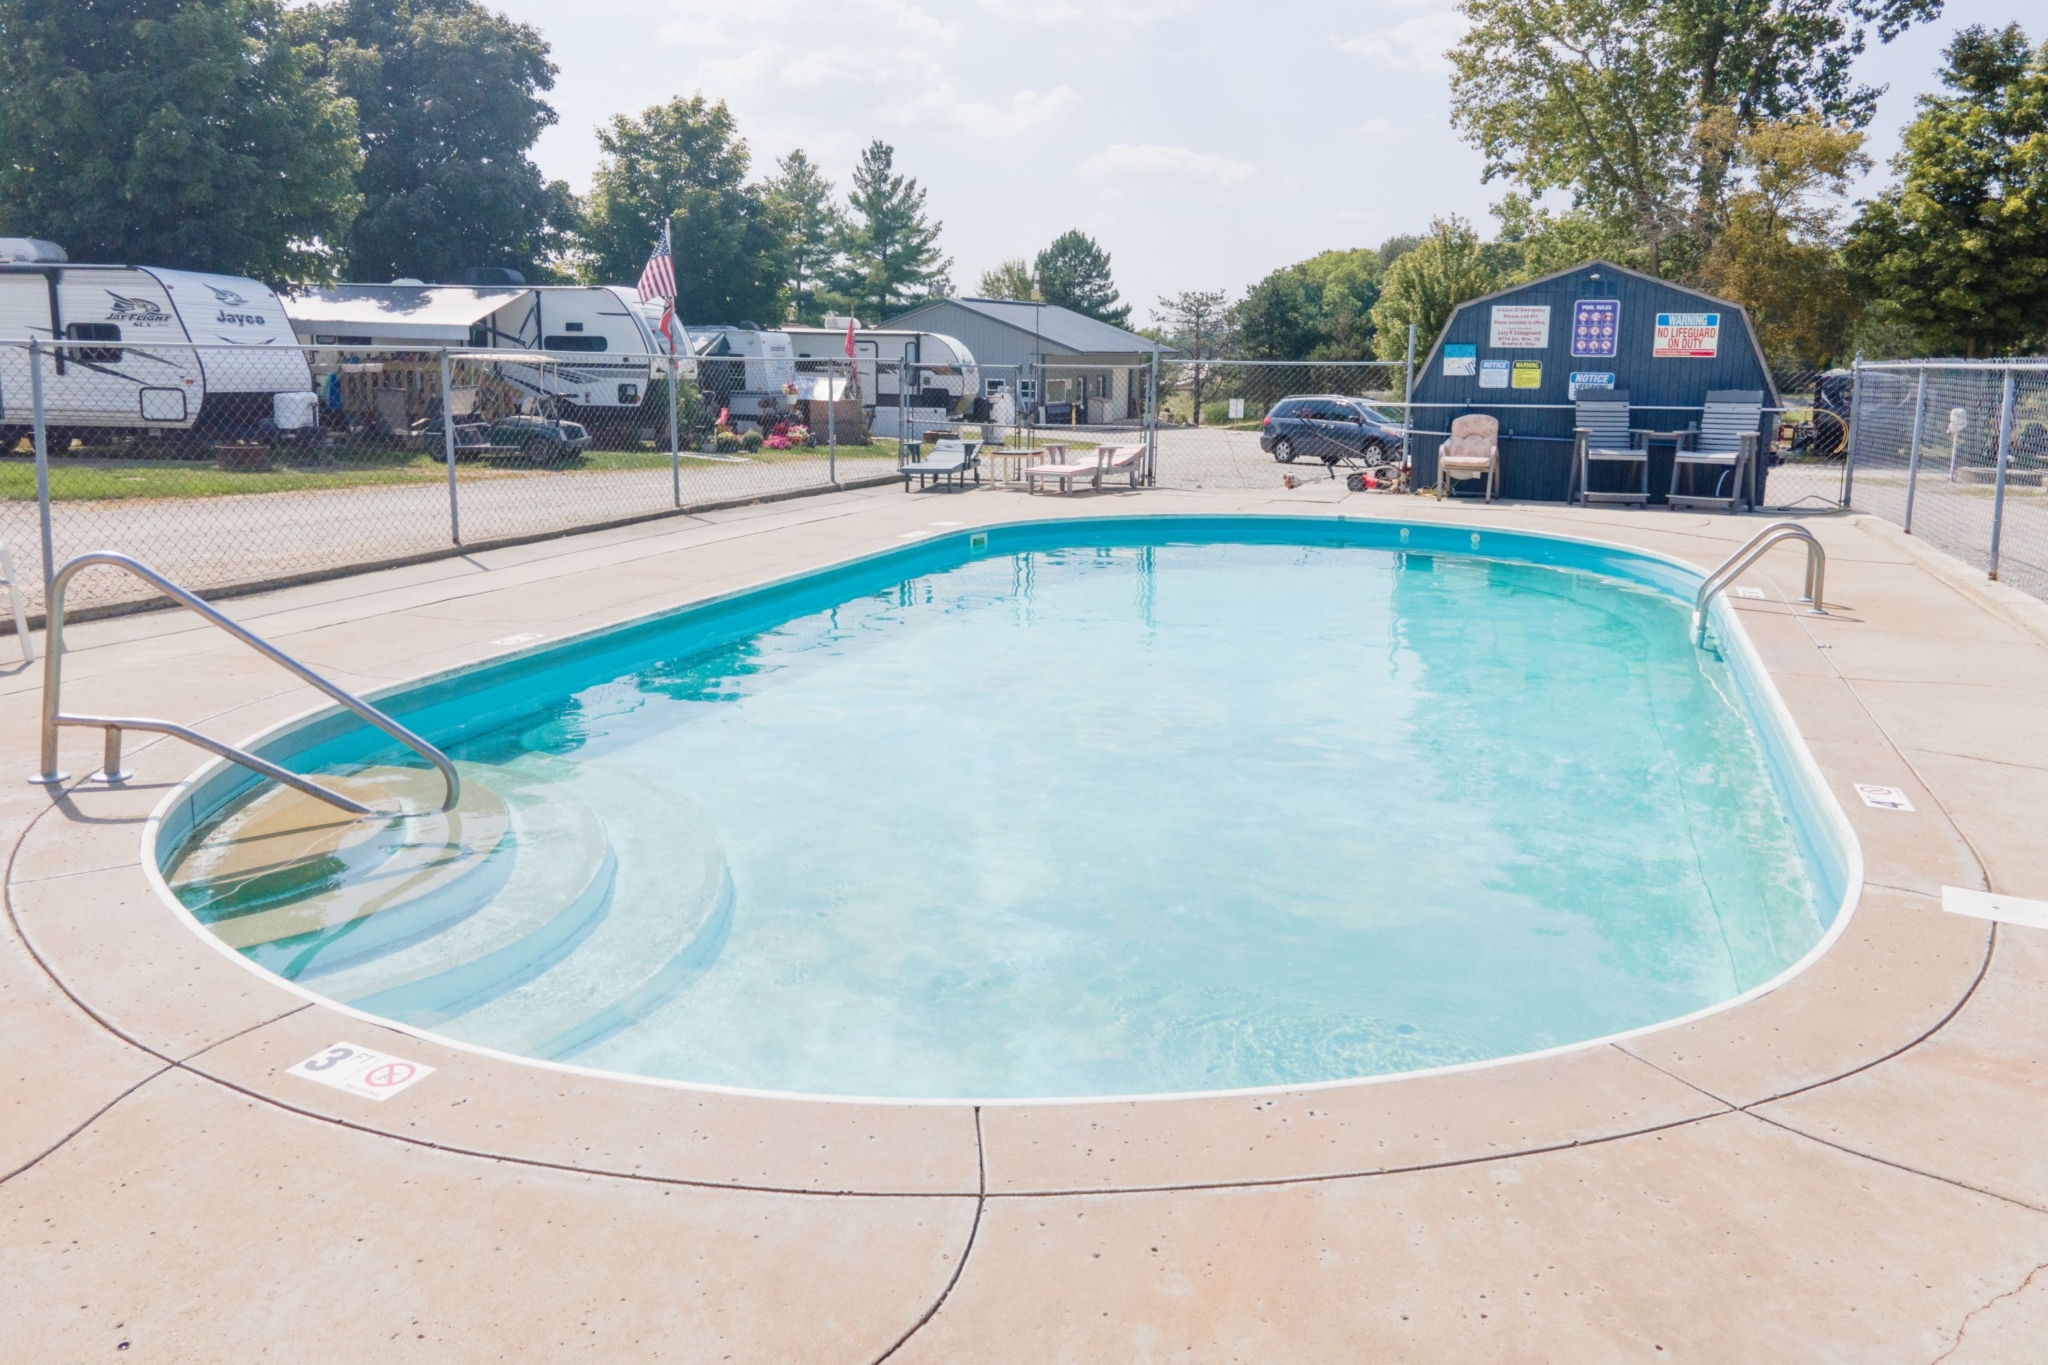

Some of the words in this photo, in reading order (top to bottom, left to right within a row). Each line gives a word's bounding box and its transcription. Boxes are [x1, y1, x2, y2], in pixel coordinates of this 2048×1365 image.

[105, 312, 128, 321] JAY
[128, 313, 172, 322] FLIGHT
[216, 309, 266, 327] Jayco
[1669, 315, 1708, 326] WARNING
[1657, 327, 1669, 338] NO
[1671, 327, 1716, 338] LIFEGUARD
[1668, 338, 1679, 348] ON
[1681, 338, 1703, 348] DUTY
[1575, 374, 1610, 383] NOTICE
[304, 1047, 354, 1071] 3
[351, 1052, 378, 1064] FT
[345, 1083, 358, 1091] NO
[358, 1086, 382, 1097] DIVING
